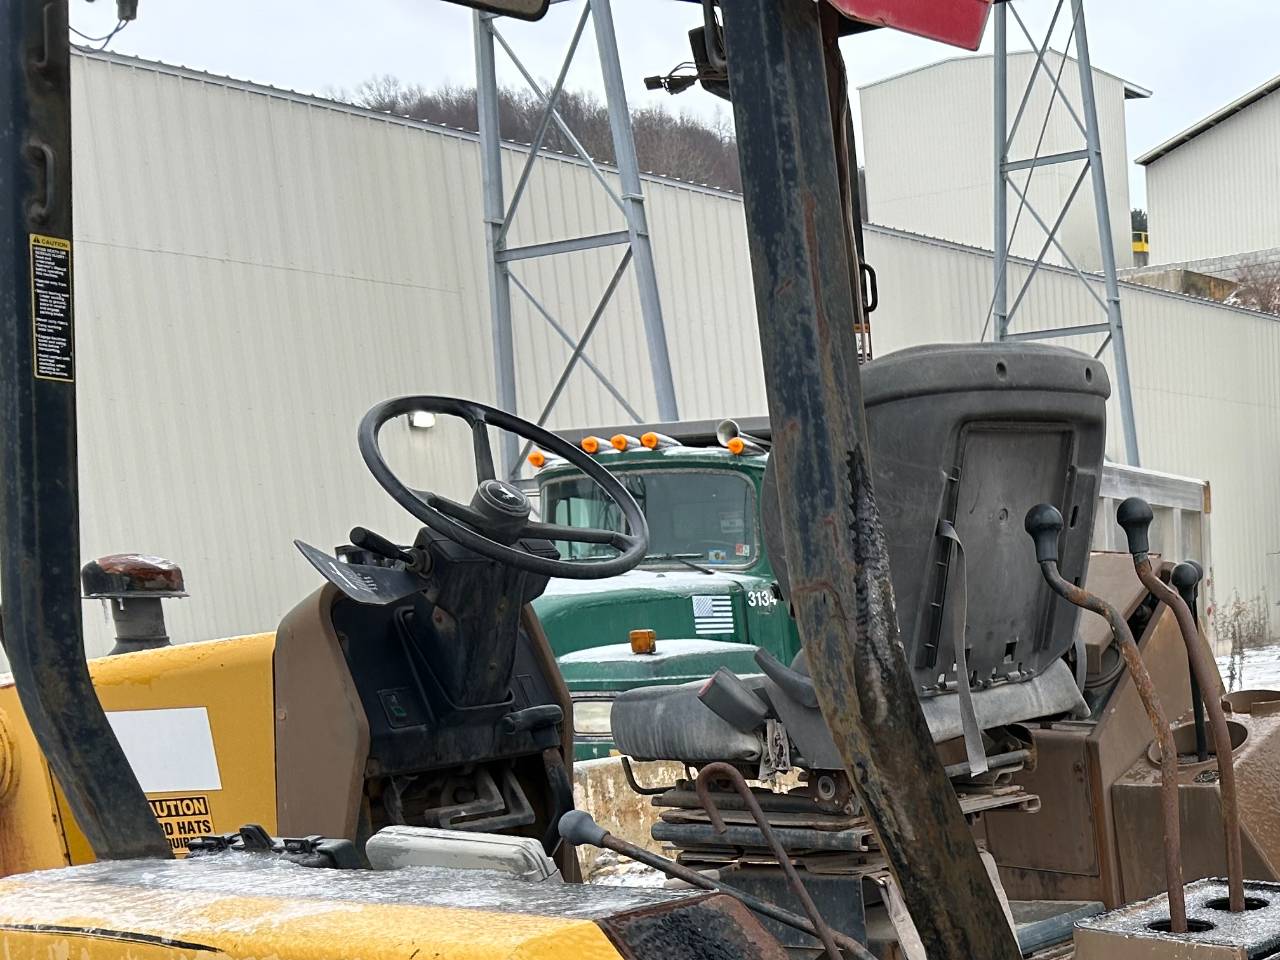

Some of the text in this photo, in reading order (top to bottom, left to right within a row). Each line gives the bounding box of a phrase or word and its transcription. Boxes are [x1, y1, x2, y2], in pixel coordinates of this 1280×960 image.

[41, 238, 68, 248] CAUTION
[748, 591, 777, 606] 3134
[149, 799, 207, 817] UTION
[177, 820, 211, 834] HATS
